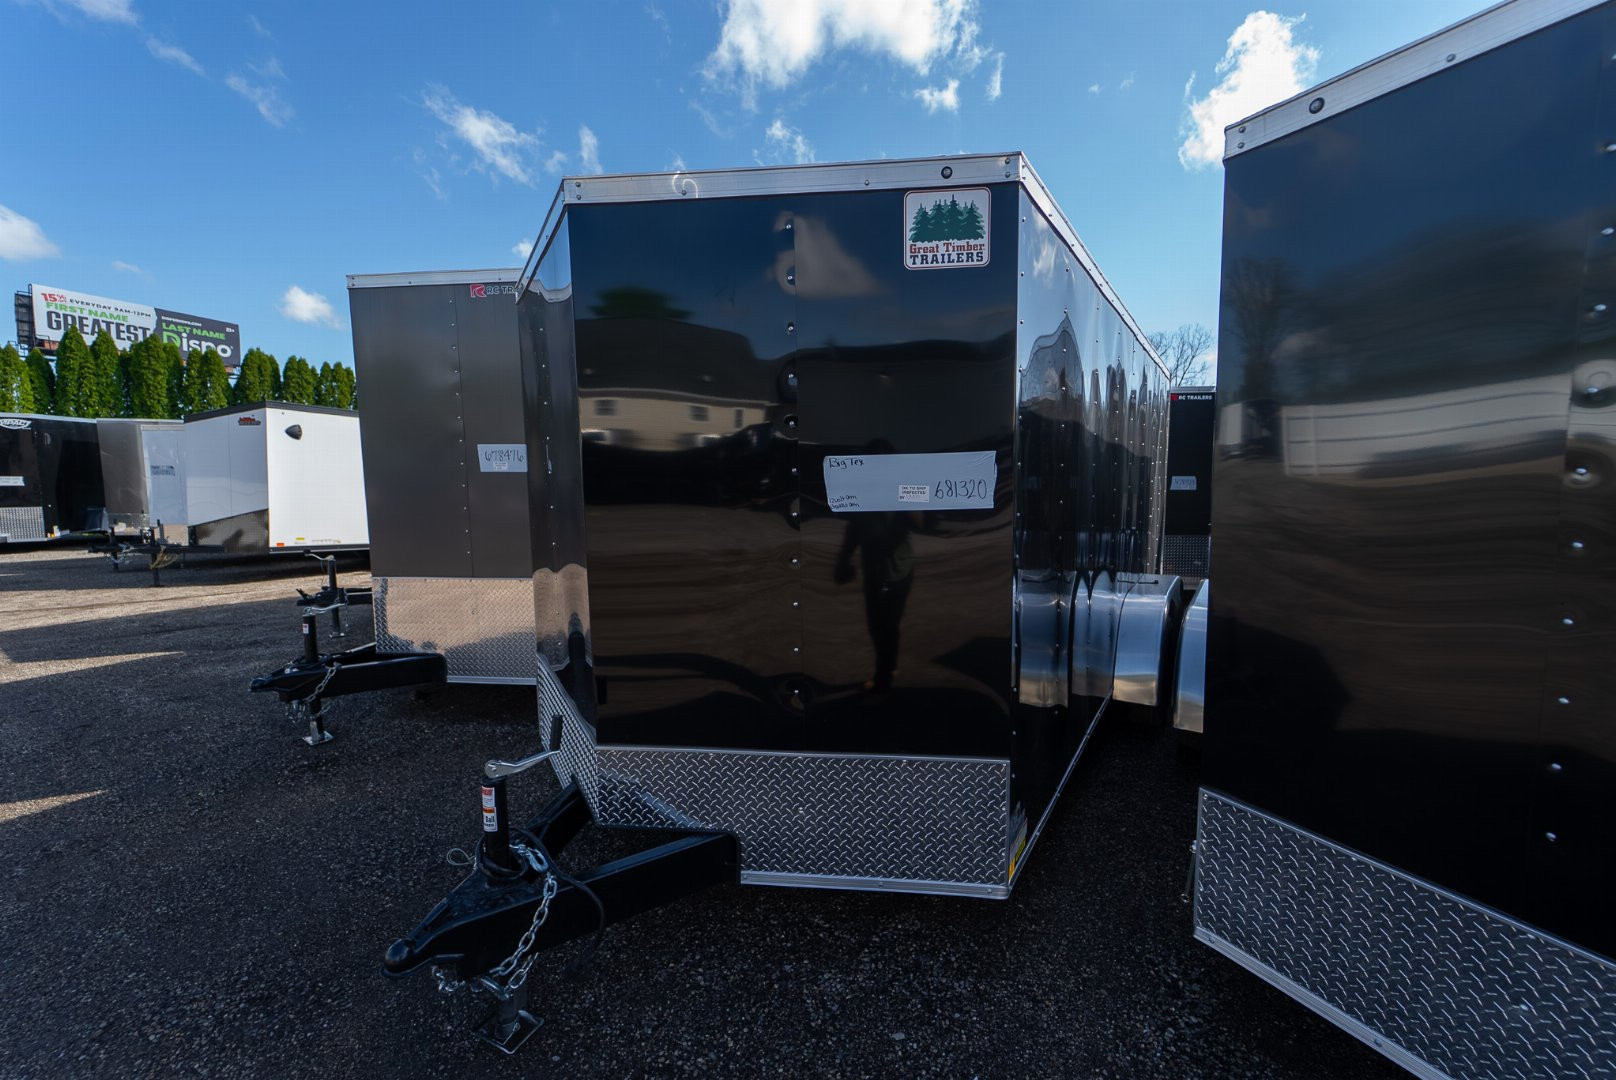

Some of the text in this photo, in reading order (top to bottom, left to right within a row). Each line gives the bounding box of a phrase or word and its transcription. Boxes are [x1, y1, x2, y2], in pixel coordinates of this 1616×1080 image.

[909, 241, 985, 254] Great Timber
[909, 251, 984, 265] TRAILERS
[45, 301, 129, 322] FIRST NAME
[69, 298, 112, 311] EVERYDAY
[46, 310, 151, 342] GREATEST
[162, 322, 226, 340] LAST NAME
[162, 331, 232, 358] Dispo
[934, 479, 988, 500] 681320
